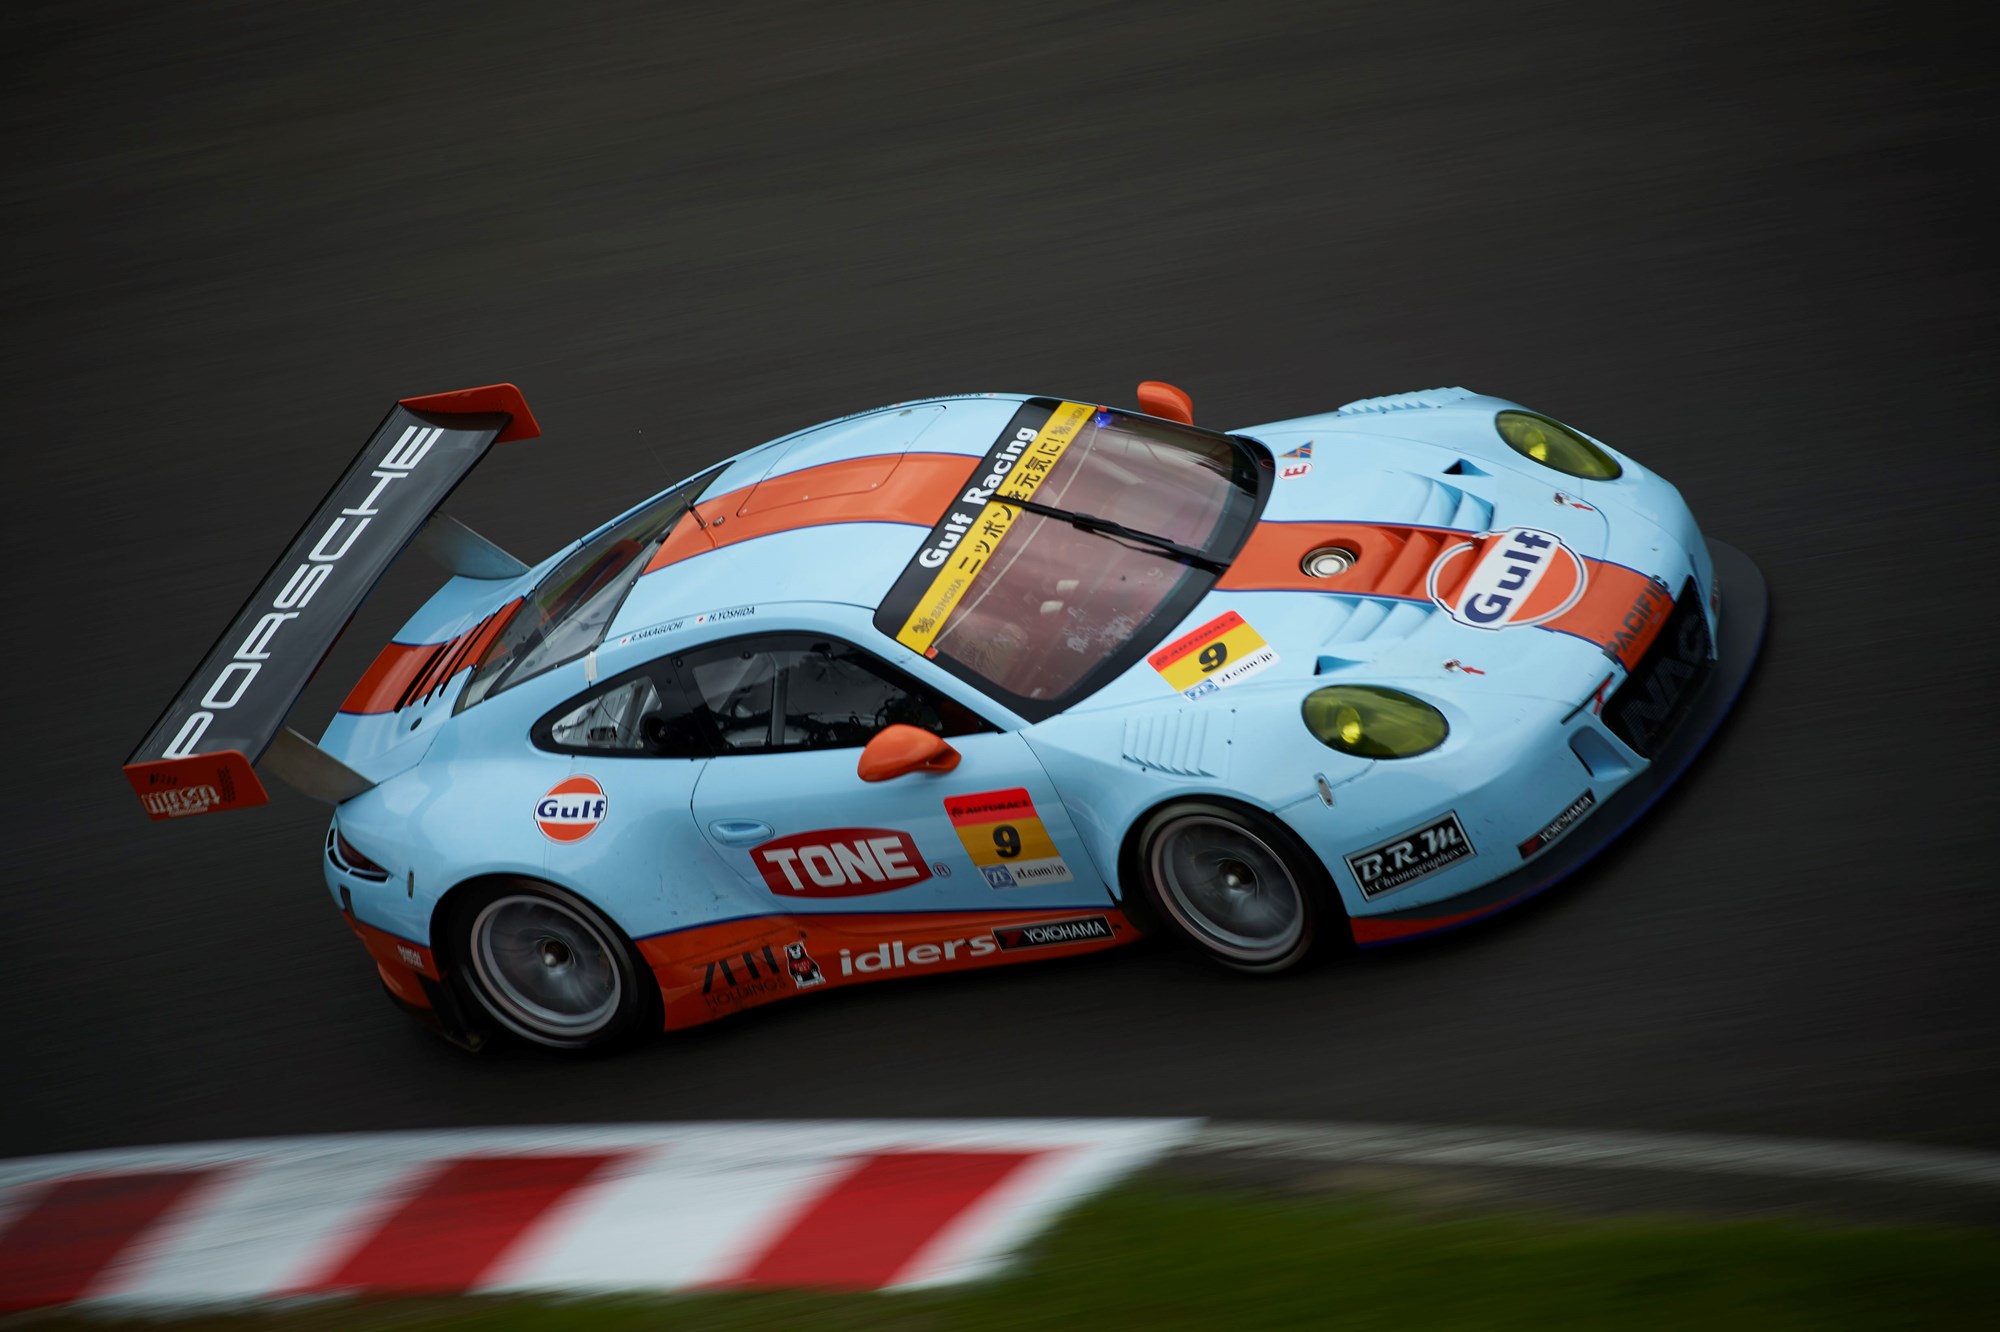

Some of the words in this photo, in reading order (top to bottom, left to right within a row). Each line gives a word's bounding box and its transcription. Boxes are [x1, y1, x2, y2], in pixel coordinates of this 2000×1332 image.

[918, 511, 974, 569] Gulf
[962, 426, 1040, 506] Racing
[161, 425, 445, 760] PORSCHE
[1464, 530, 1552, 624] Gulf
[1601, 574, 1671, 666] PACIFIC
[1198, 641, 1228, 674] 9
[537, 799, 605, 819] Gulf
[763, 836, 920, 891] TONE
[993, 824, 1022, 858] 9
[839, 932, 997, 977] idlers
[1023, 920, 1106, 943] YOKOHAMA
